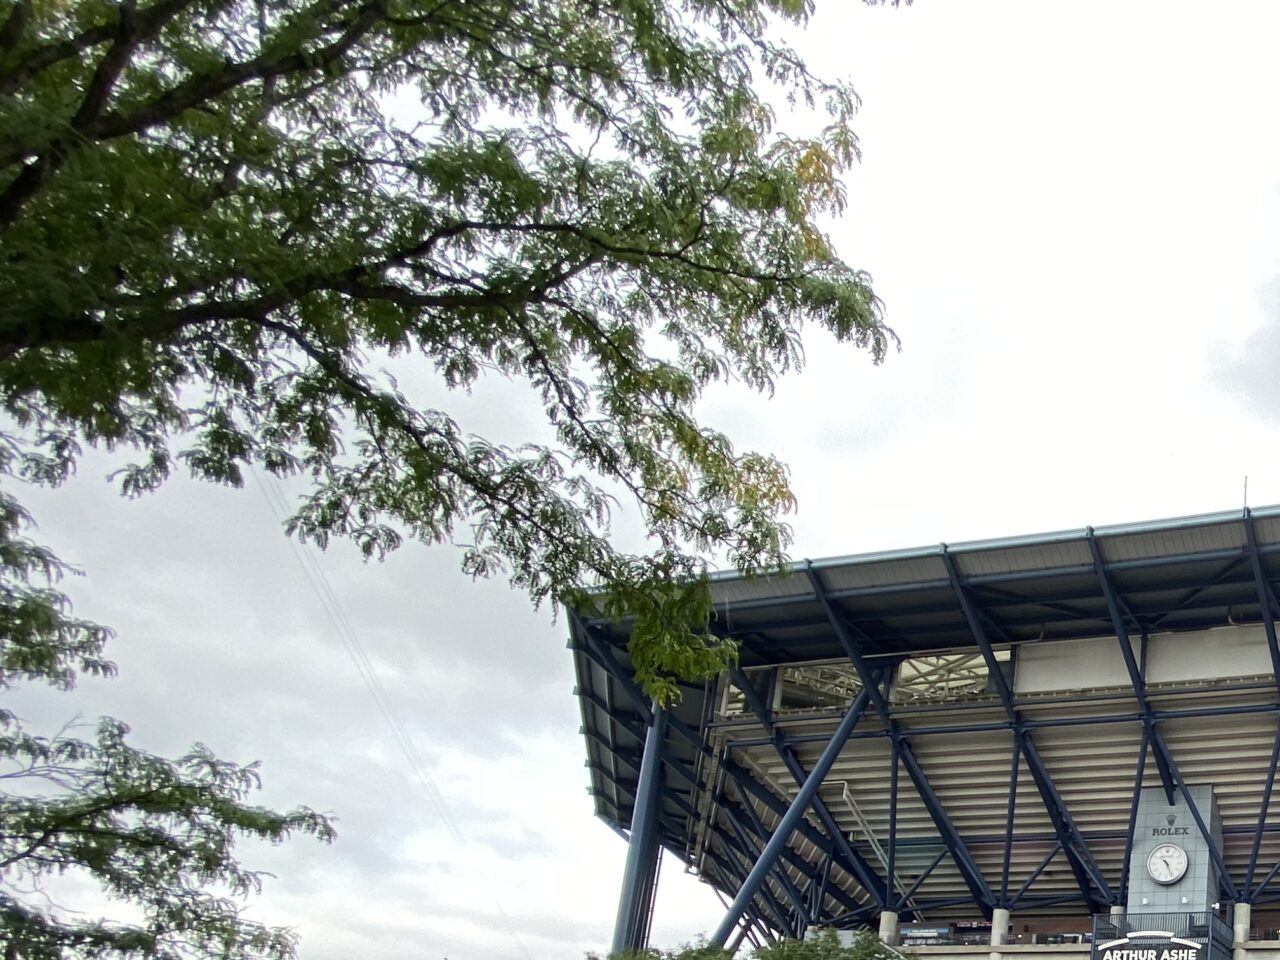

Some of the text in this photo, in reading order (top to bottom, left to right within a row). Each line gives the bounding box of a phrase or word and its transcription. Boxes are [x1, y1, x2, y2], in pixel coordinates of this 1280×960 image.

[1152, 827, 1189, 836] ROLEX
[1103, 949, 1197, 960] ARTHUR ASHE
